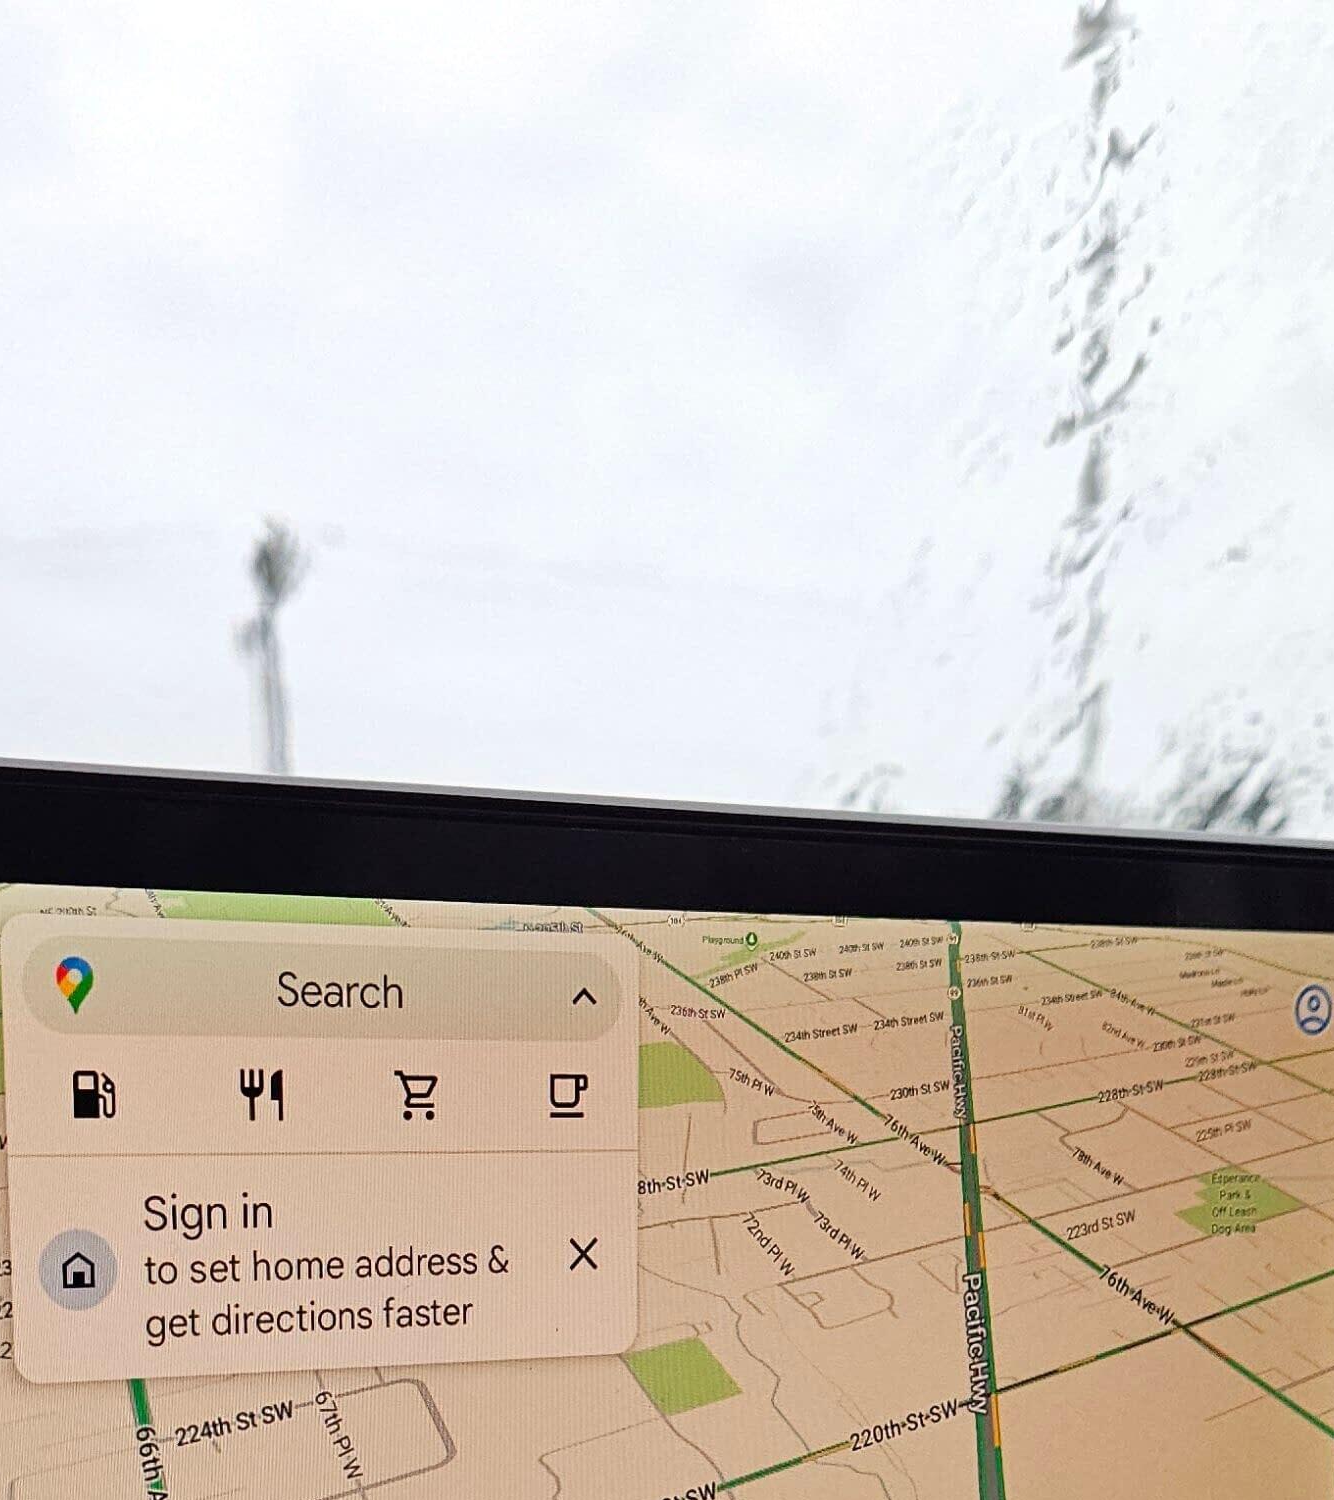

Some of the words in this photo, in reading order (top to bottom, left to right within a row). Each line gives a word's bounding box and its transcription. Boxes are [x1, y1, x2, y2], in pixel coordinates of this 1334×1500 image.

[702, 935, 744, 945] Playground
[744, 962, 759, 974] SW
[277, 971, 404, 1009] Search
[698, 1008, 708, 1019] St
[710, 1009, 725, 1019] SW
[874, 1019, 898, 1031] 234th
[900, 1015, 927, 1027] Street
[929, 1011, 944, 1023] SW
[785, 1030, 811, 1043] 234th
[812, 1026, 840, 1039] Street
[842, 1024, 858, 1036] SW
[950, 1025, 966, 1084] Pacific
[1241, 1061, 1257, 1073] SW
[729, 1068, 750, 1085] 75th
[751, 1077, 764, 1092] Pl
[766, 1085, 776, 1097] W
[890, 1086, 918, 1101] 230th
[920, 1083, 932, 1097] St
[933, 1080, 950, 1093] SW
[1098, 1087, 1129, 1103] 228th
[1132, 1084, 1143, 1097] St
[1146, 1079, 1163, 1095] SW
[953, 1083, 967, 1119] Hwy
[826, 1118, 846, 1137] Ave
[846, 1132, 858, 1145] W
[884, 1113, 909, 1140] 76th
[909, 1132, 932, 1158] Ave
[932, 1150, 946, 1168] W
[637, 1178, 661, 1195] 8th
[666, 1176, 681, 1190] St
[685, 1170, 709, 1185] SW
[833, 1160, 856, 1184] 74th
[857, 1177, 869, 1193] Pl
[869, 1189, 881, 1202] W
[1072, 1146, 1092, 1167] 78th
[1094, 1160, 1113, 1179] Ave
[1113, 1174, 1124, 1186] W
[1211, 1173, 1261, 1185] Esperance
[757, 1170, 783, 1190] 73rd
[784, 1179, 798, 1195] Pl
[797, 1189, 810, 1203] W
[1219, 1190, 1241, 1200] Park
[143, 1193, 228, 1241] Sign
[242, 1193, 274, 1230] in
[1067, 1219, 1099, 1241] 223rd
[1101, 1215, 1114, 1229] St
[1116, 1209, 1136, 1225] SW
[1212, 1207, 1227, 1216] Off
[742, 1212, 770, 1248] 72nd
[768, 1243, 783, 1264] Pl
[779, 1260, 795, 1276] W
[814, 1211, 841, 1243] 73rd
[839, 1233, 853, 1252] Pl
[852, 1248, 866, 1262] W
[1211, 1224, 1232, 1236] Dog
[1234, 1224, 1256, 1234] Area
[144, 1255, 179, 1286] to
[189, 1252, 242, 1284] set
[252, 1248, 345, 1282] home
[355, 1245, 479, 1279] address
[487, 1245, 510, 1275] &
[1100, 1266, 1131, 1296] 76th
[1130, 1288, 1157, 1315] Ave
[1158, 1308, 1175, 1326] W
[145, 1310, 201, 1348] get
[212, 1300, 374, 1337] directions
[383, 1296, 474, 1330] faster
[963, 1273, 987, 1358] Pacific
[966, 1358, 989, 1415] Hwy
[174, 1418, 232, 1448] 224th
[236, 1411, 259, 1434] St
[261, 1400, 294, 1426] SW
[315, 1390, 340, 1438] 67th
[332, 1434, 354, 1458] Pl
[344, 1456, 363, 1481] W
[850, 1420, 902, 1452] 220th
[906, 1409, 926, 1433] St
[930, 1398, 958, 1424] SW
[136, 1426, 162, 1482] 66th
